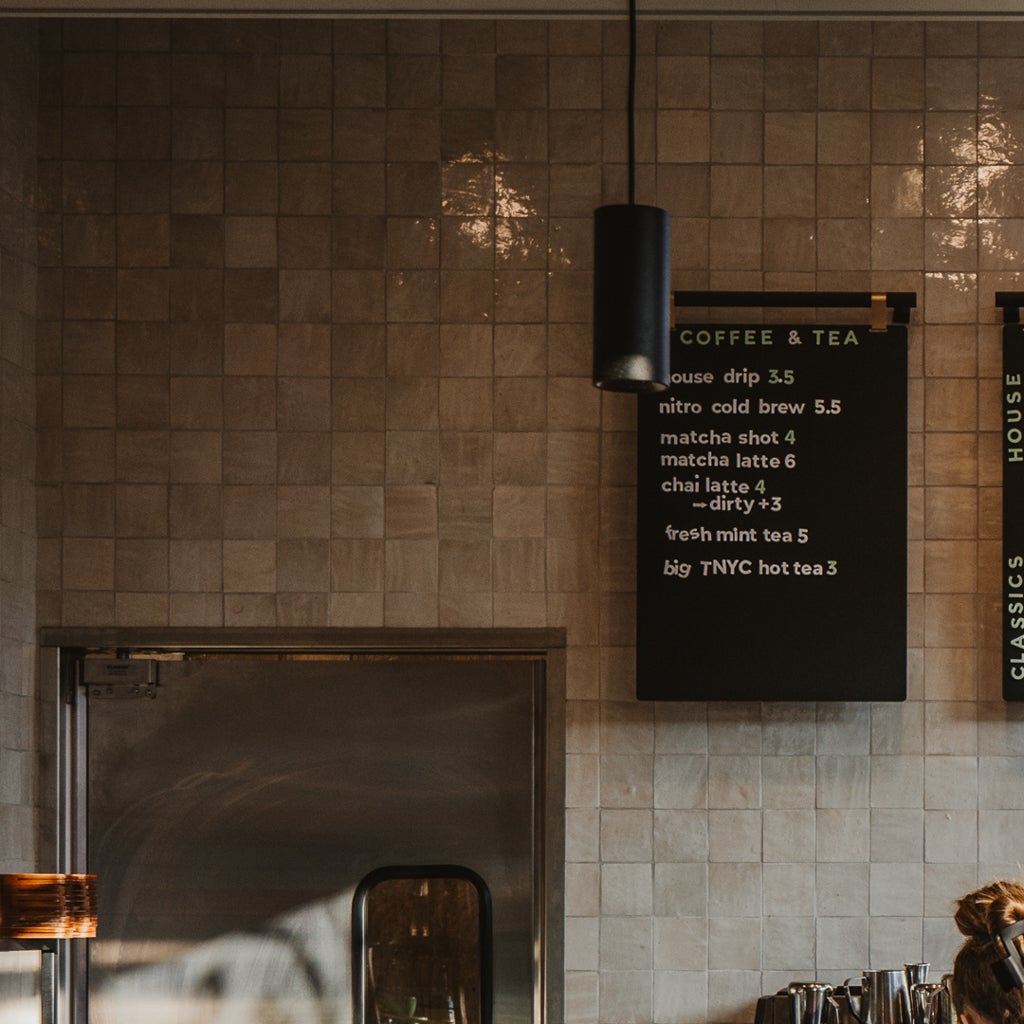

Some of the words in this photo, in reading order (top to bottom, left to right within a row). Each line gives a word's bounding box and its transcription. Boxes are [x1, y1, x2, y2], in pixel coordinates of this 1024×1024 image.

[680, 330, 773, 346] COFFEE
[788, 330, 802, 345] &
[812, 330, 859, 346] TEA
[669, 370, 714, 384] ouse
[723, 368, 760, 387] drip
[768, 369, 795, 385] 3.5
[659, 397, 702, 414] nitro
[711, 399, 749, 414] cold
[758, 399, 805, 414] brew
[814, 399, 841, 415] 5.5
[1006, 373, 1024, 462] HOUSE
[660, 430, 732, 445] matcha
[738, 430, 779, 445] shot
[784, 430, 796, 444] 4
[660, 452, 729, 467] matcha
[736, 453, 780, 468] latte
[784, 454, 796, 468] 6
[661, 474, 700, 493] chai
[706, 478, 749, 494] latte
[754, 480, 766, 494] 4
[665, 525, 712, 542] fresh
[716, 527, 757, 542] mint
[762, 529, 793, 543] tea
[797, 528, 809, 544] 5
[663, 559, 691, 578] big
[700, 559, 752, 576] TNYC
[758, 560, 789, 576] hot
[793, 561, 823, 576] tea
[826, 560, 837, 576] 3
